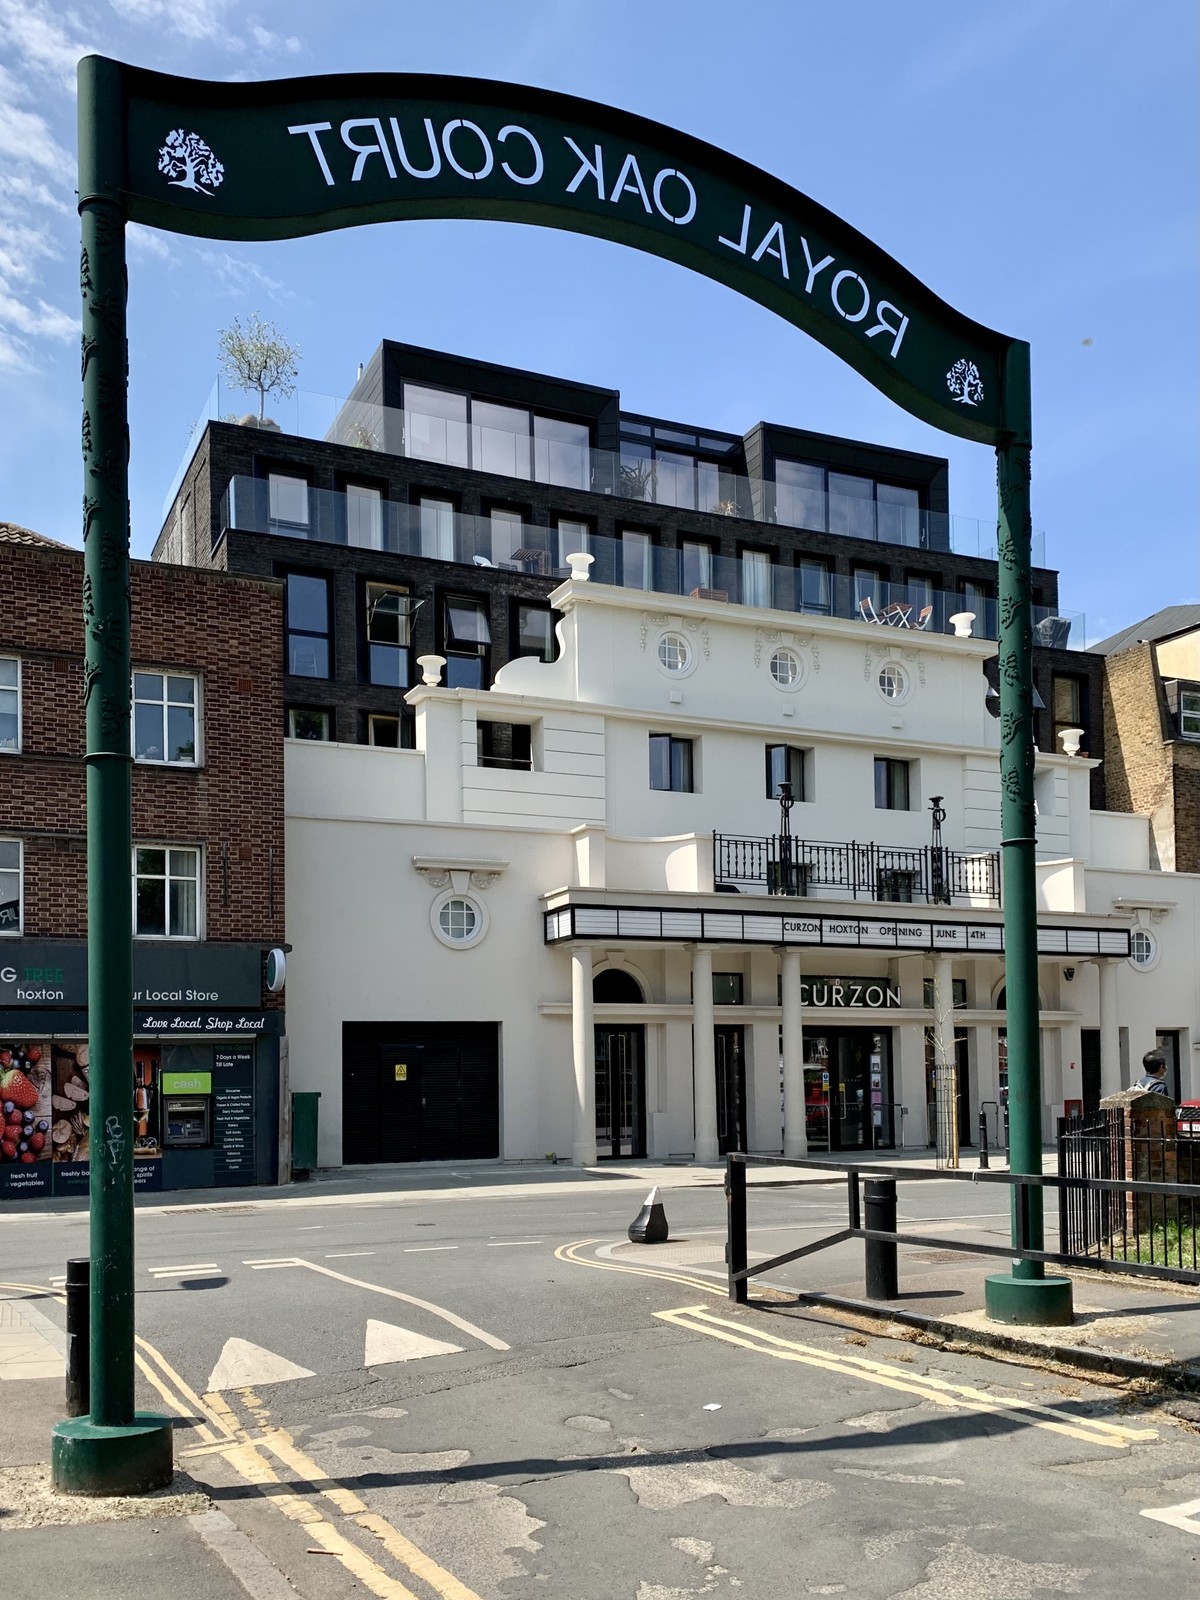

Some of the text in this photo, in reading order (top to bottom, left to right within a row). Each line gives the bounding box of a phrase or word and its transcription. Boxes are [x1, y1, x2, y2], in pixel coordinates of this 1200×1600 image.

[784, 921, 986, 939] CURZON HOXTON OPENING JUNE 4TH
[0, 967, 64, 983] G TREE
[17, 988, 64, 1000] hoxton
[132, 989, 219, 1001] ur Local Store
[800, 984, 901, 1008] CURZON
[142, 1016, 168, 1028] Love
[205, 1017, 233, 1032] Shop
[235, 1017, 265, 1029] Local
[173, 1078, 202, 1089] cash
[26, 1171, 38, 1179] fruit
[10, 1180, 45, 1188] vegetables
